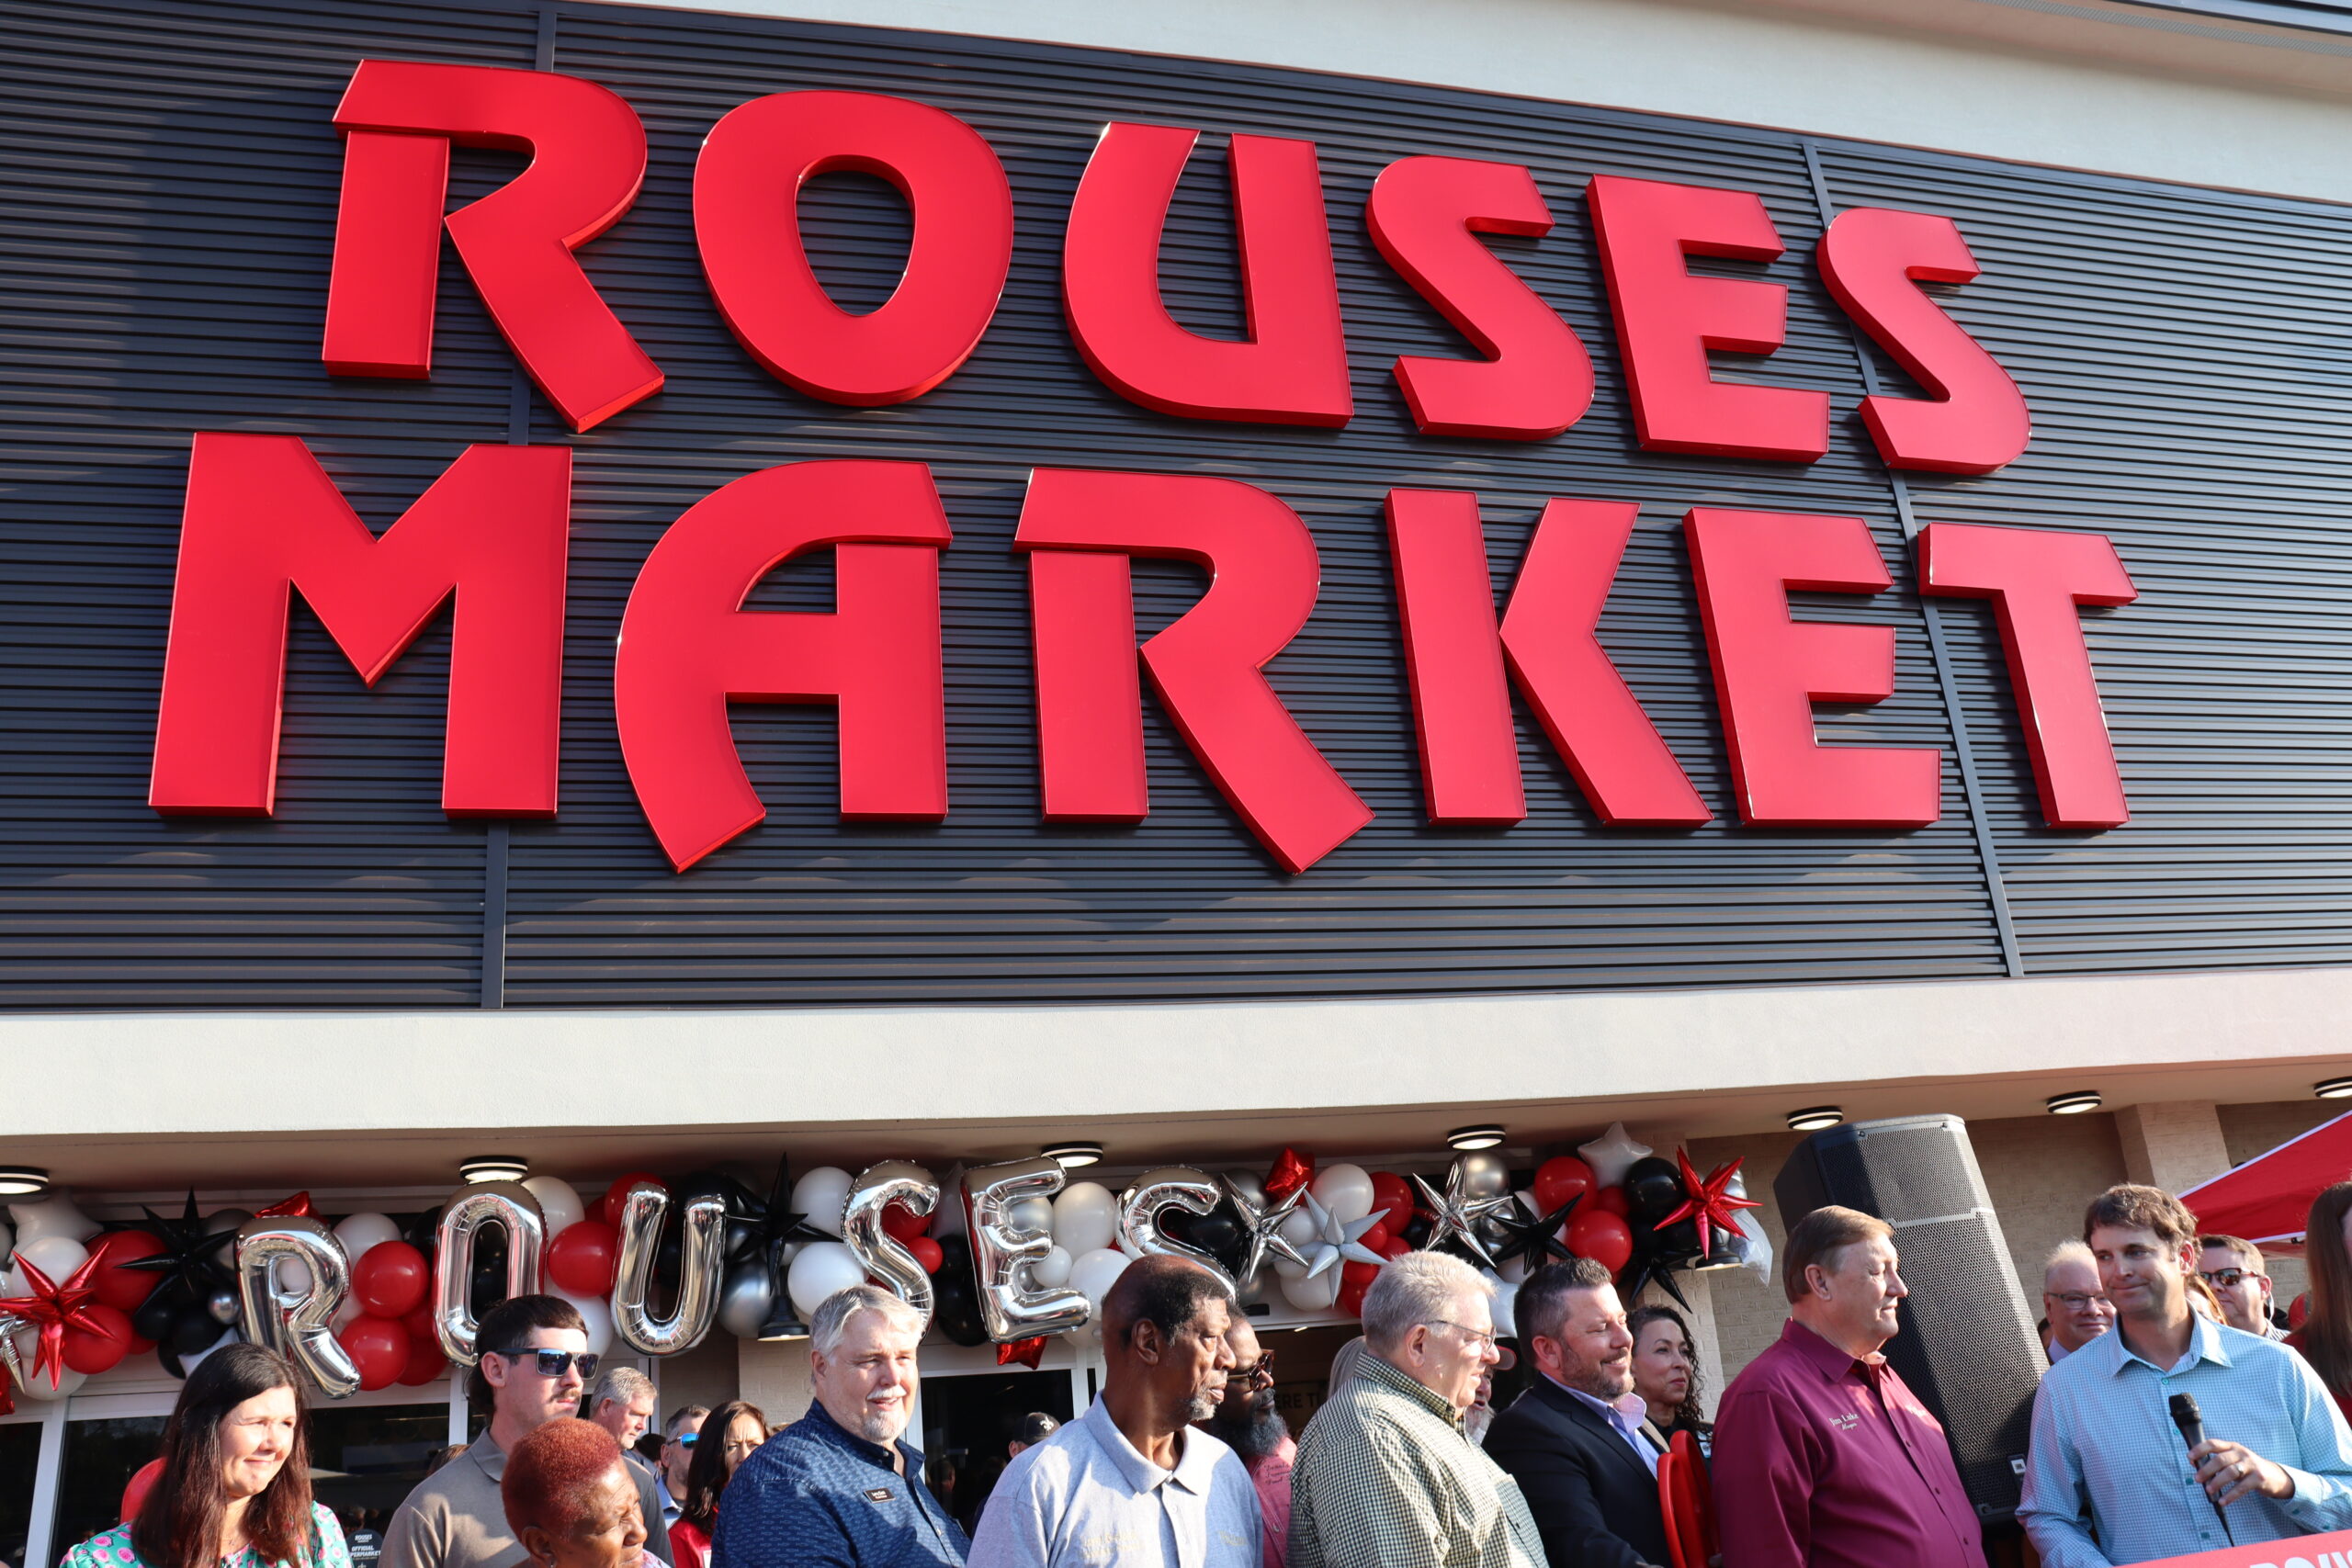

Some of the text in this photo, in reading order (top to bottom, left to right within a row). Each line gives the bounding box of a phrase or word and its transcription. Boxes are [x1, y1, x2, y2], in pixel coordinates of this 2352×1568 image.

[322, 59, 2032, 477] ROUSES
[149, 433, 2138, 875] MARKET
[235, 1156, 1238, 1399] ROUSES
